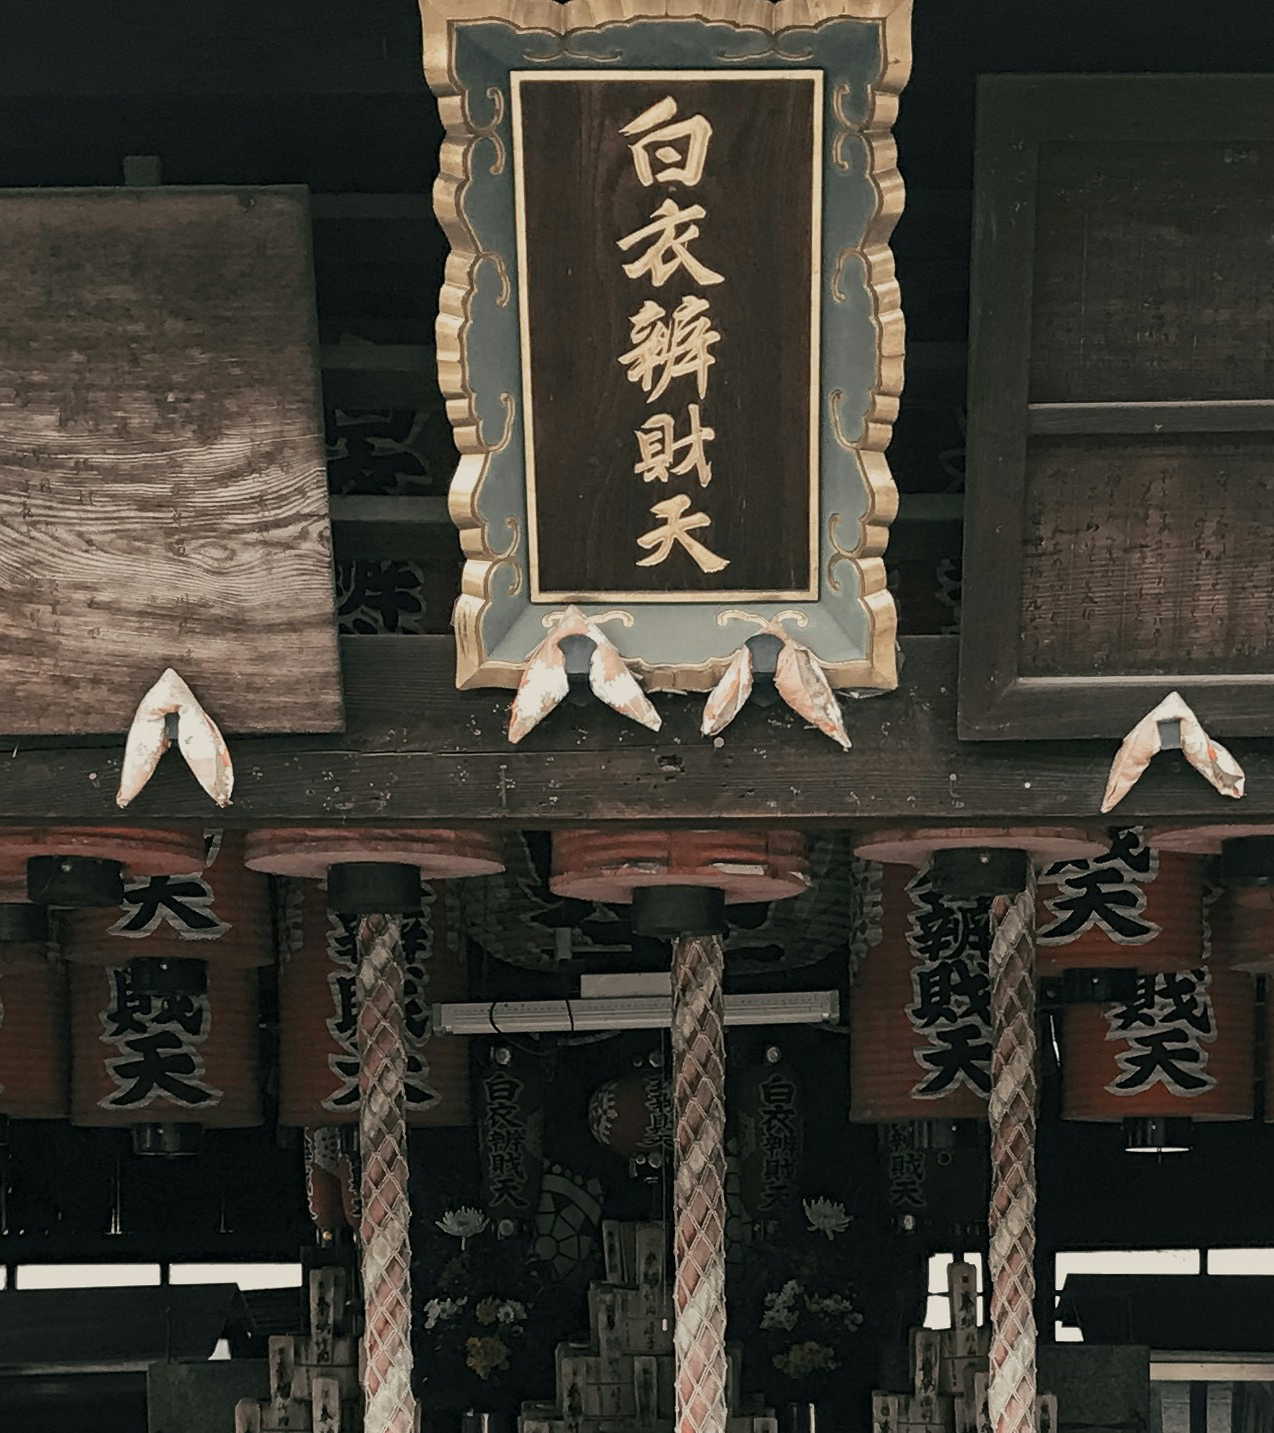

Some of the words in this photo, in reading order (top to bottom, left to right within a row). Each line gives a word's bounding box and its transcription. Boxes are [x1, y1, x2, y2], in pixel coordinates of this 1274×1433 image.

[618, 97, 729, 573] 白衣辨財天
